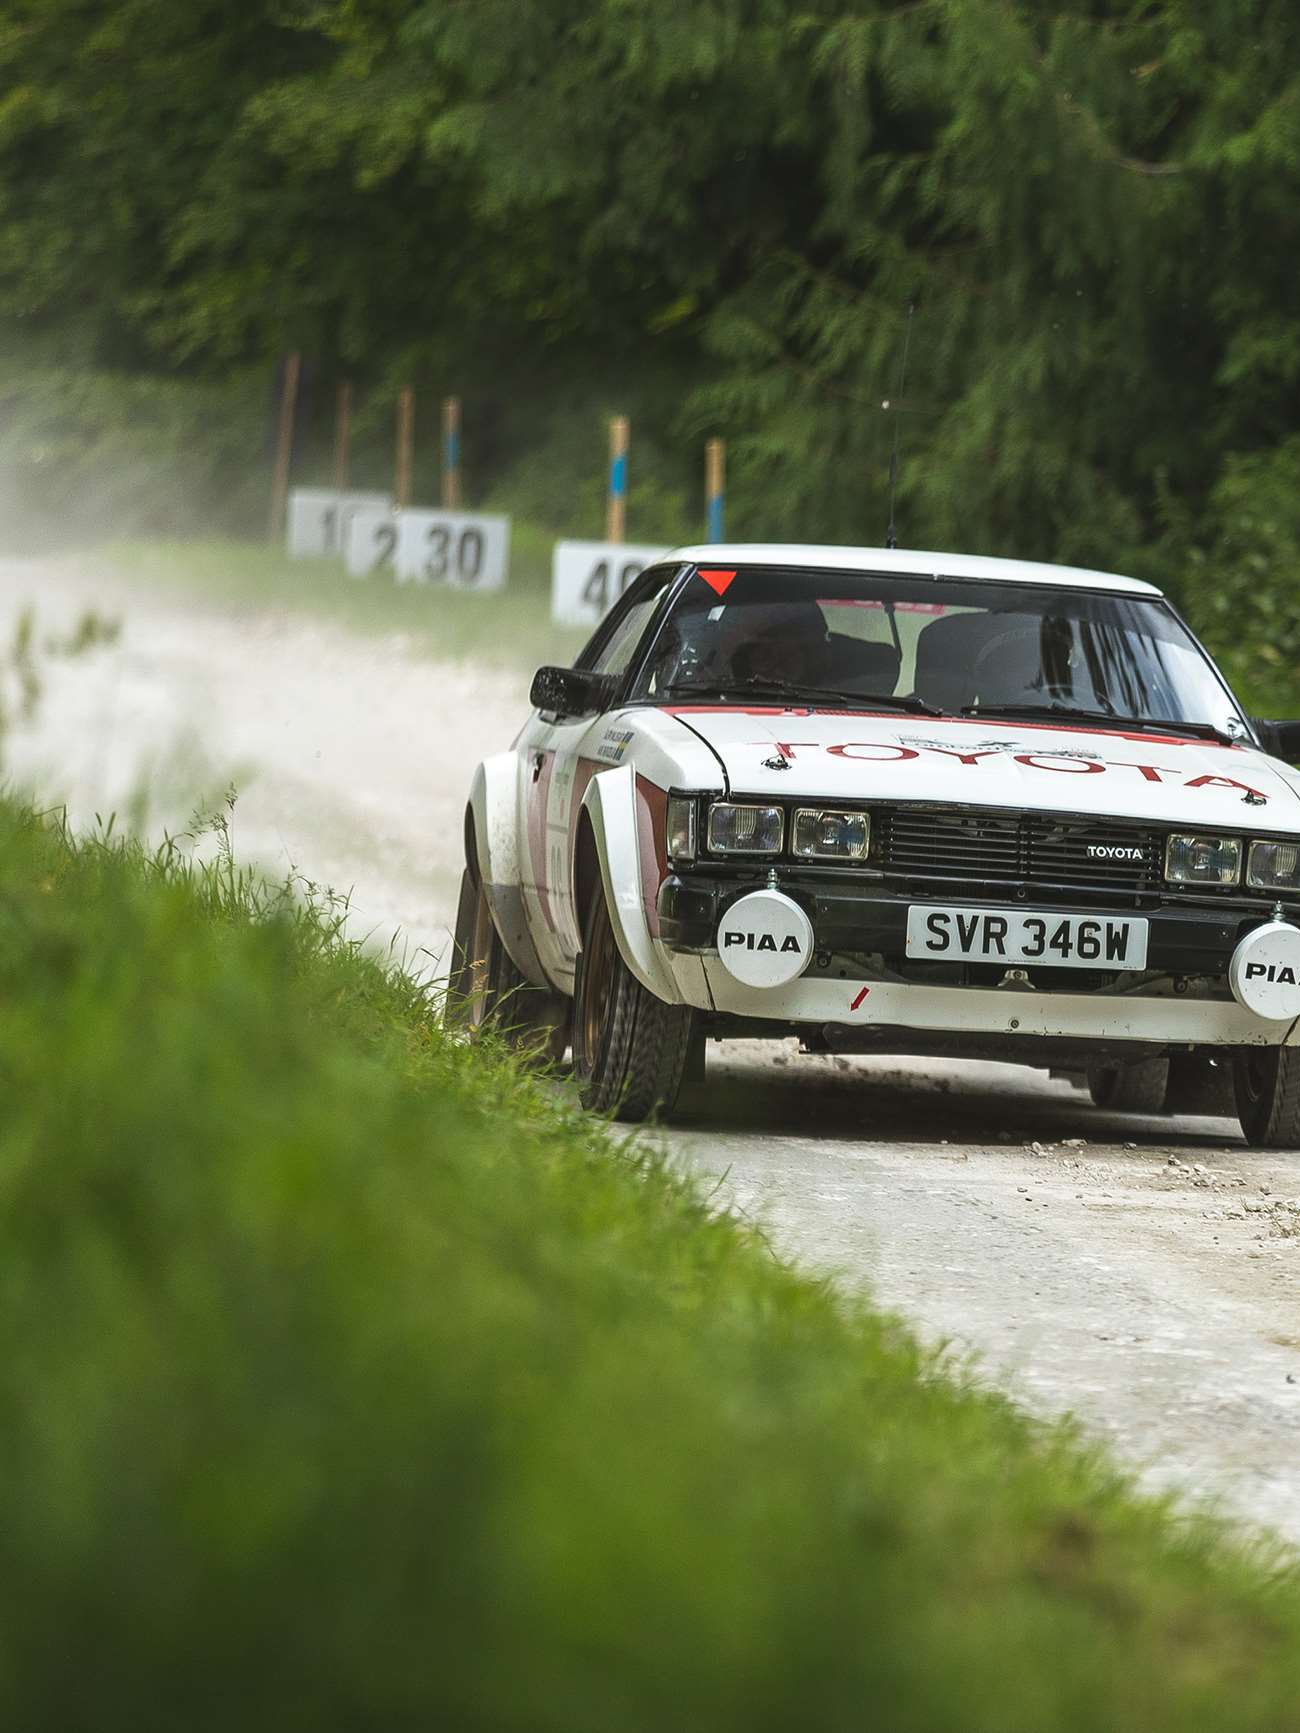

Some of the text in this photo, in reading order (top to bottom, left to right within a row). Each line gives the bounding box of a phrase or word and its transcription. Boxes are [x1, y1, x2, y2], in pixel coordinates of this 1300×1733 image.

[426, 521, 486, 584] 30
[749, 742, 1270, 799] TOYOTA
[1087, 845, 1143, 860] TOYOTA
[724, 931, 801, 953] PIAA
[926, 912, 1130, 962] SVR 346W
